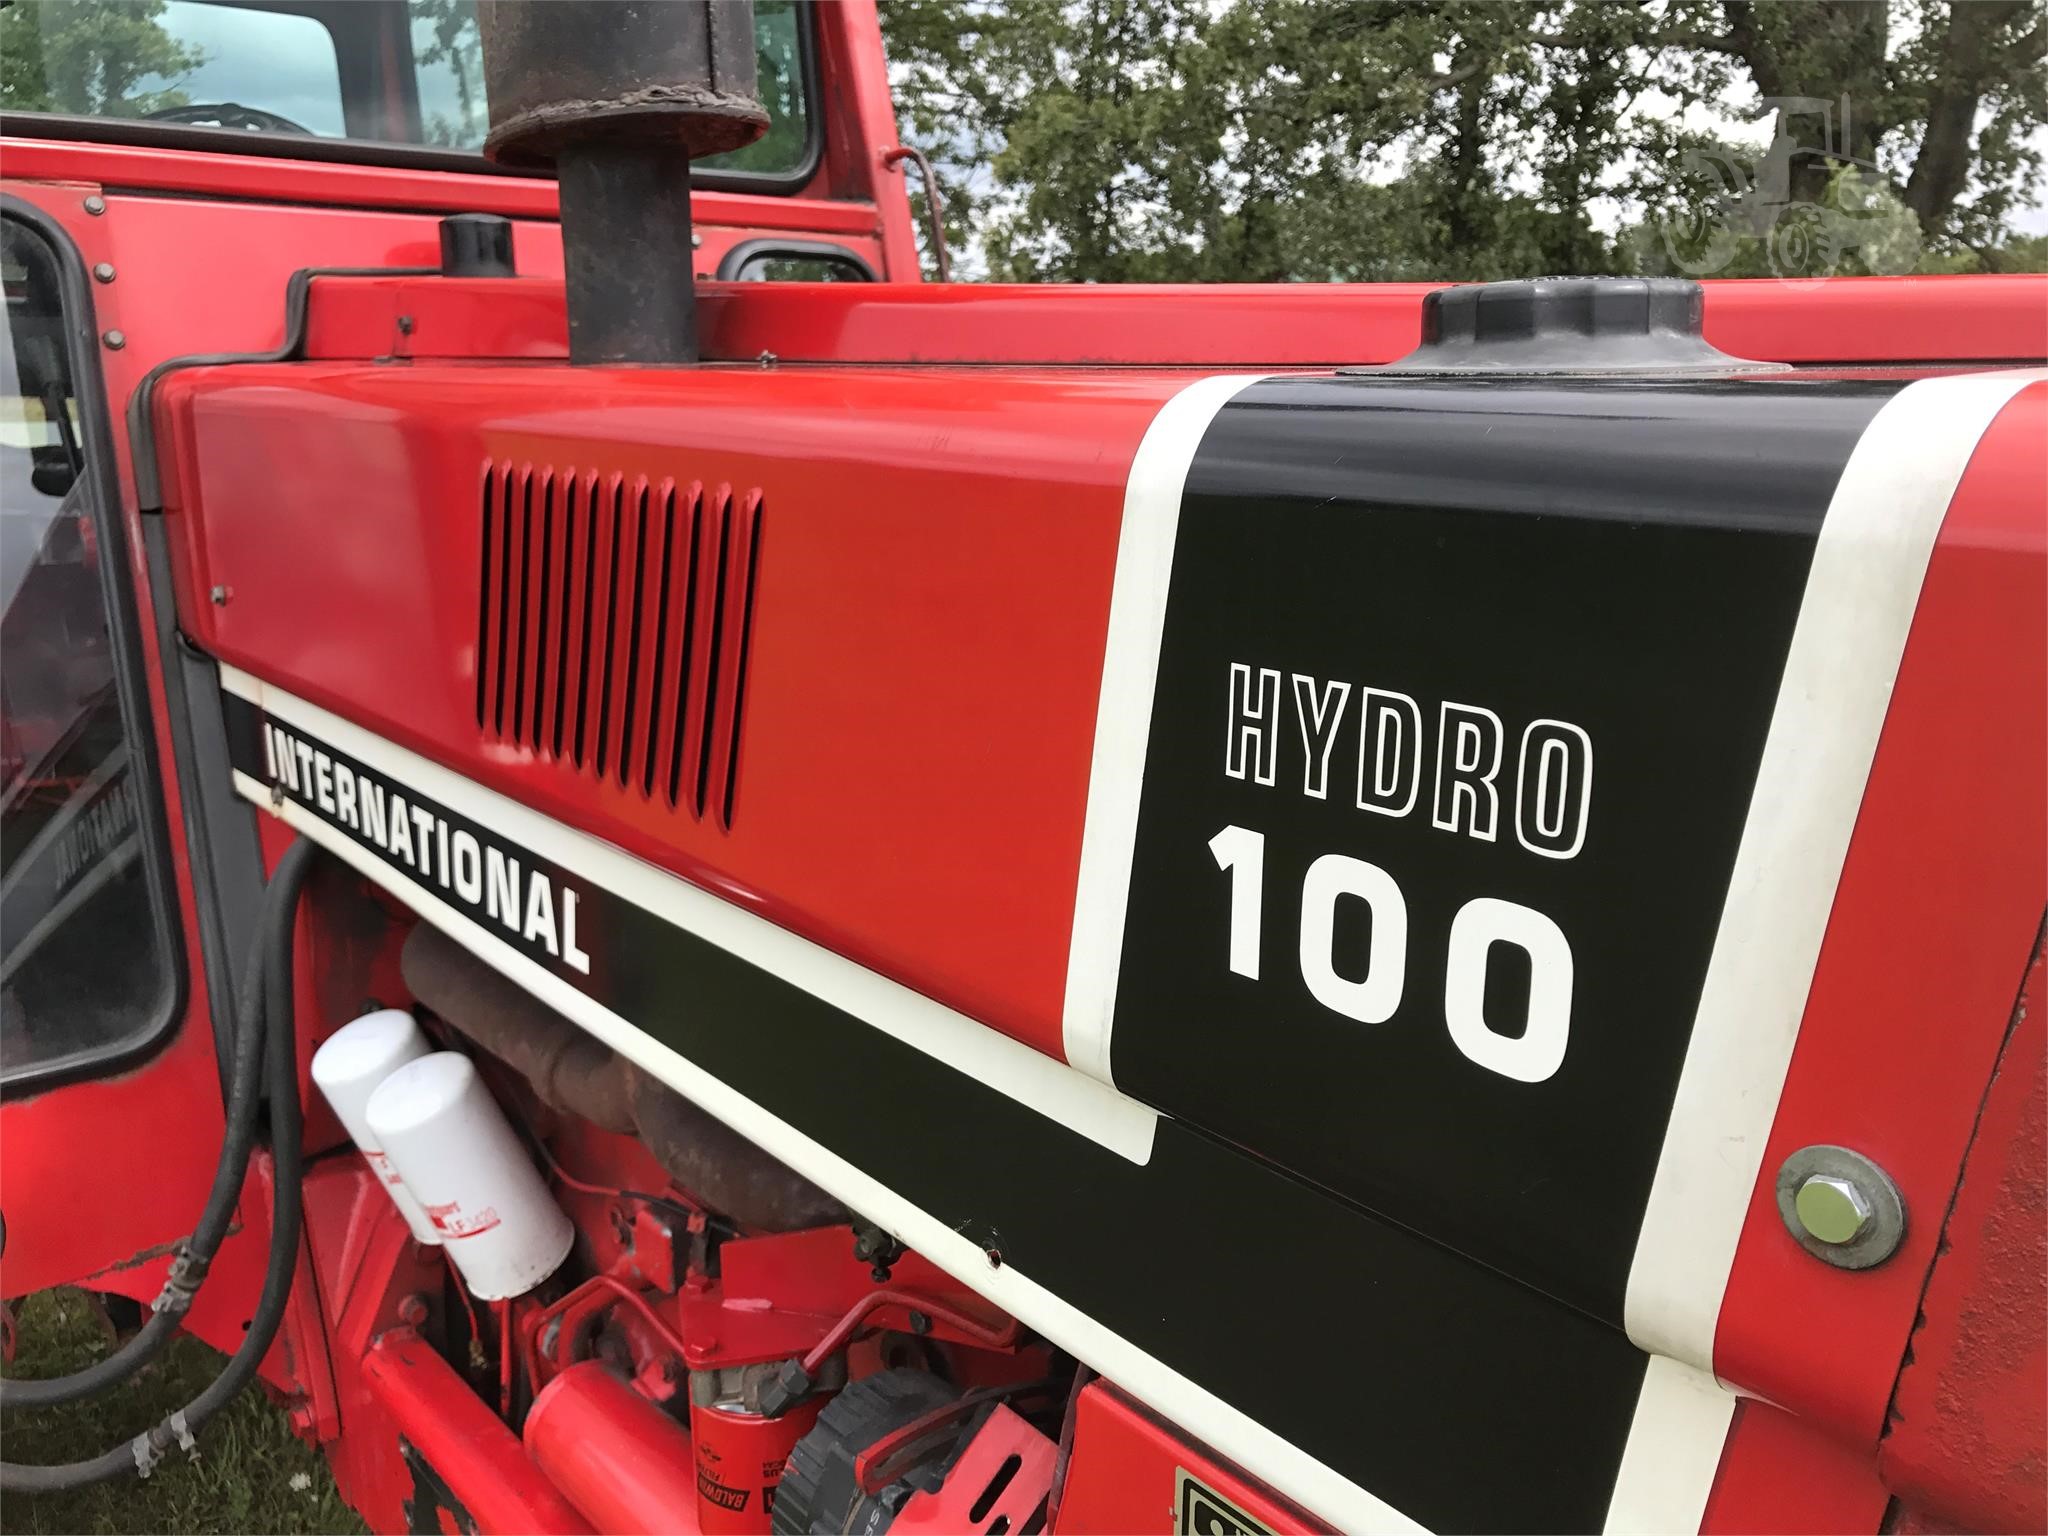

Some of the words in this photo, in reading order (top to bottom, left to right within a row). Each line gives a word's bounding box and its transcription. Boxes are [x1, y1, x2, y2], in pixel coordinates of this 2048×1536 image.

[264, 722, 590, 976] INTERNATIONAL
[1225, 662, 1594, 860] HYDRO
[1208, 824, 1574, 1083] 100
